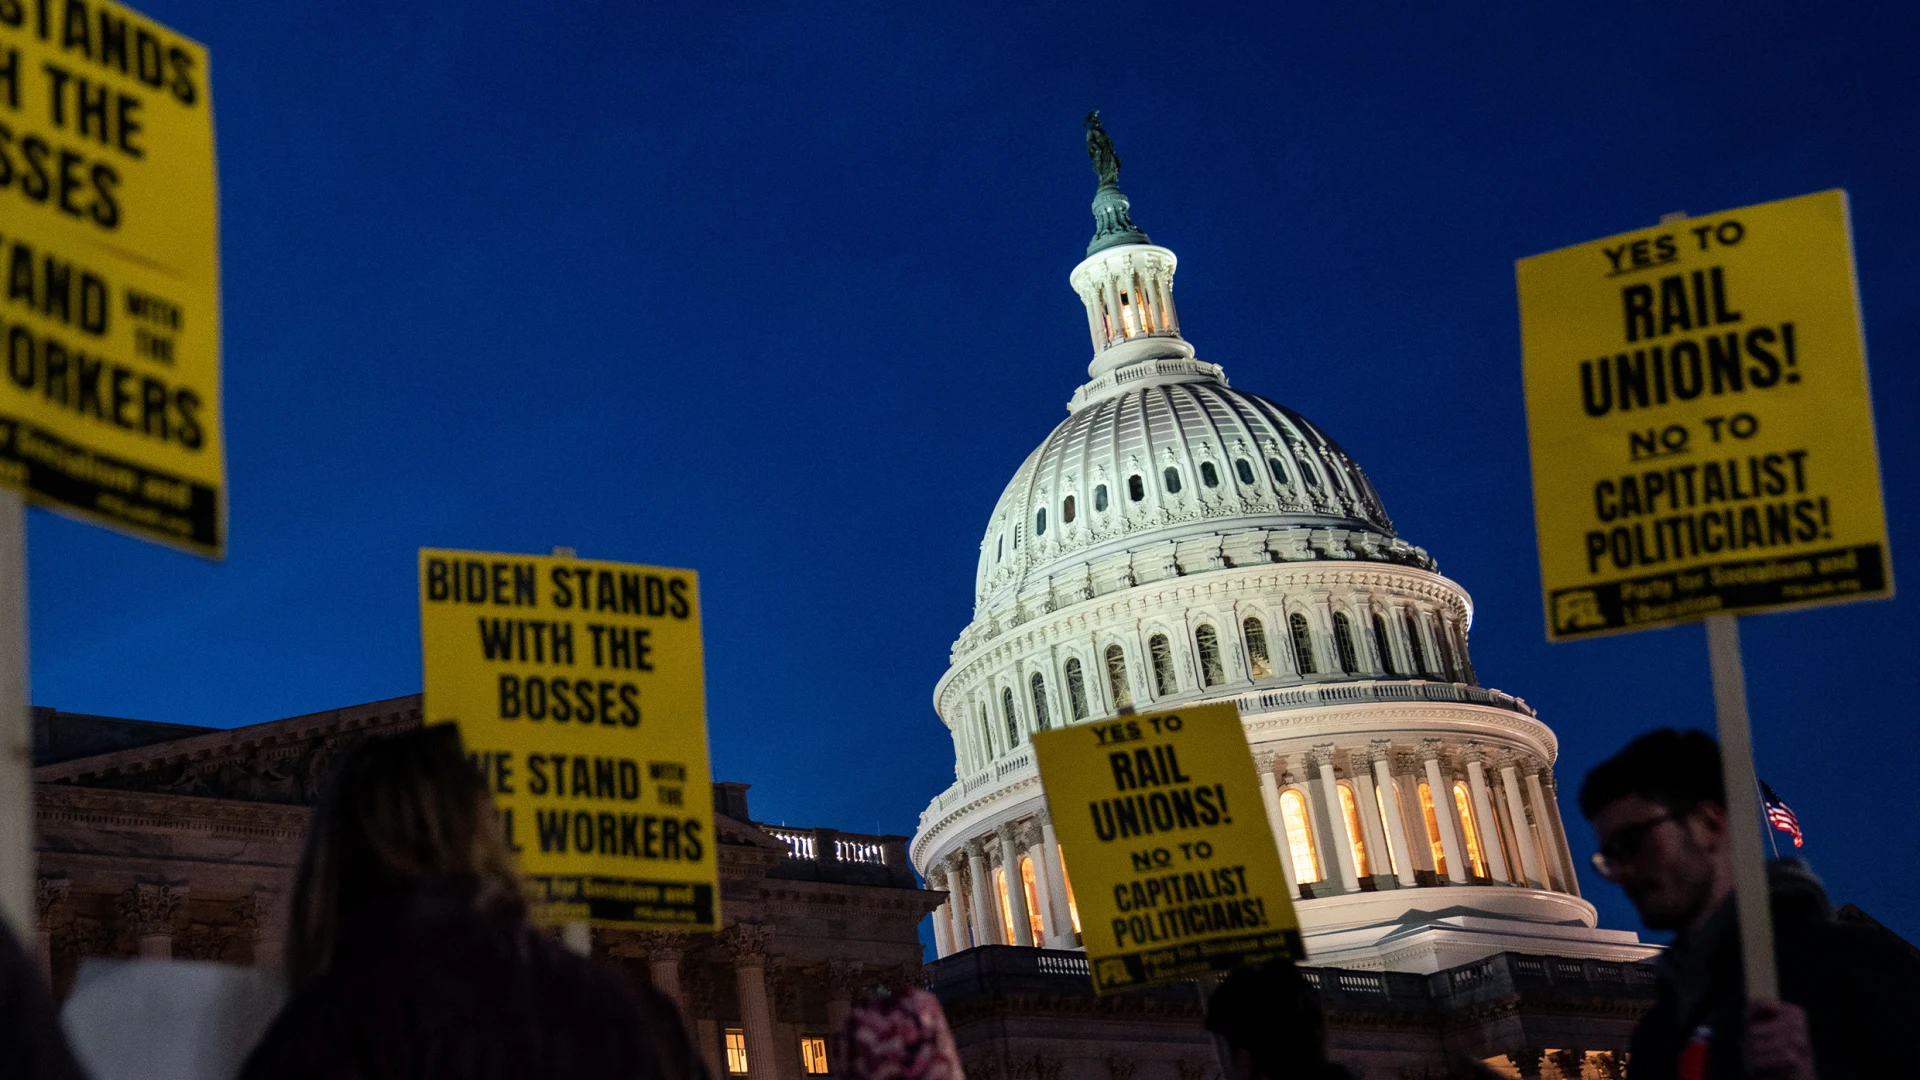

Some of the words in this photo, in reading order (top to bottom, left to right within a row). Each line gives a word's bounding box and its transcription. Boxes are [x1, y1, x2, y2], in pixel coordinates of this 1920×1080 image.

[43, 63, 143, 160] THE
[1602, 234, 1678, 275] YES
[1691, 219, 1745, 251] TO
[2, 240, 108, 336] AND
[1621, 265, 1742, 343] RAIL
[3, 322, 206, 449] ORKERS
[1580, 322, 1801, 417] UNIONS!
[1629, 424, 1690, 460] NO
[1703, 412, 1760, 443] TO
[1594, 450, 1808, 523] CAPITALIST
[1586, 496, 1832, 574] POLITICIANS!
[427, 558, 536, 607] BIDEN
[550, 565, 690, 620] STANDS
[478, 615, 575, 667] WITH
[586, 621, 654, 673] THE
[499, 672, 641, 728] BOSSES
[1092, 719, 1143, 745] YES
[1150, 714, 1183, 735] TO
[526, 753, 640, 801] STAND
[1109, 743, 1191, 792] RAIL
[536, 808, 705, 862] WORKERS
[1089, 783, 1233, 842] UNIONS!
[1131, 847, 1172, 870] NO
[1178, 841, 1214, 861] TO
[1112, 865, 1249, 914] CAPITALIST
[1111, 897, 1269, 949] POLITICIANS!
